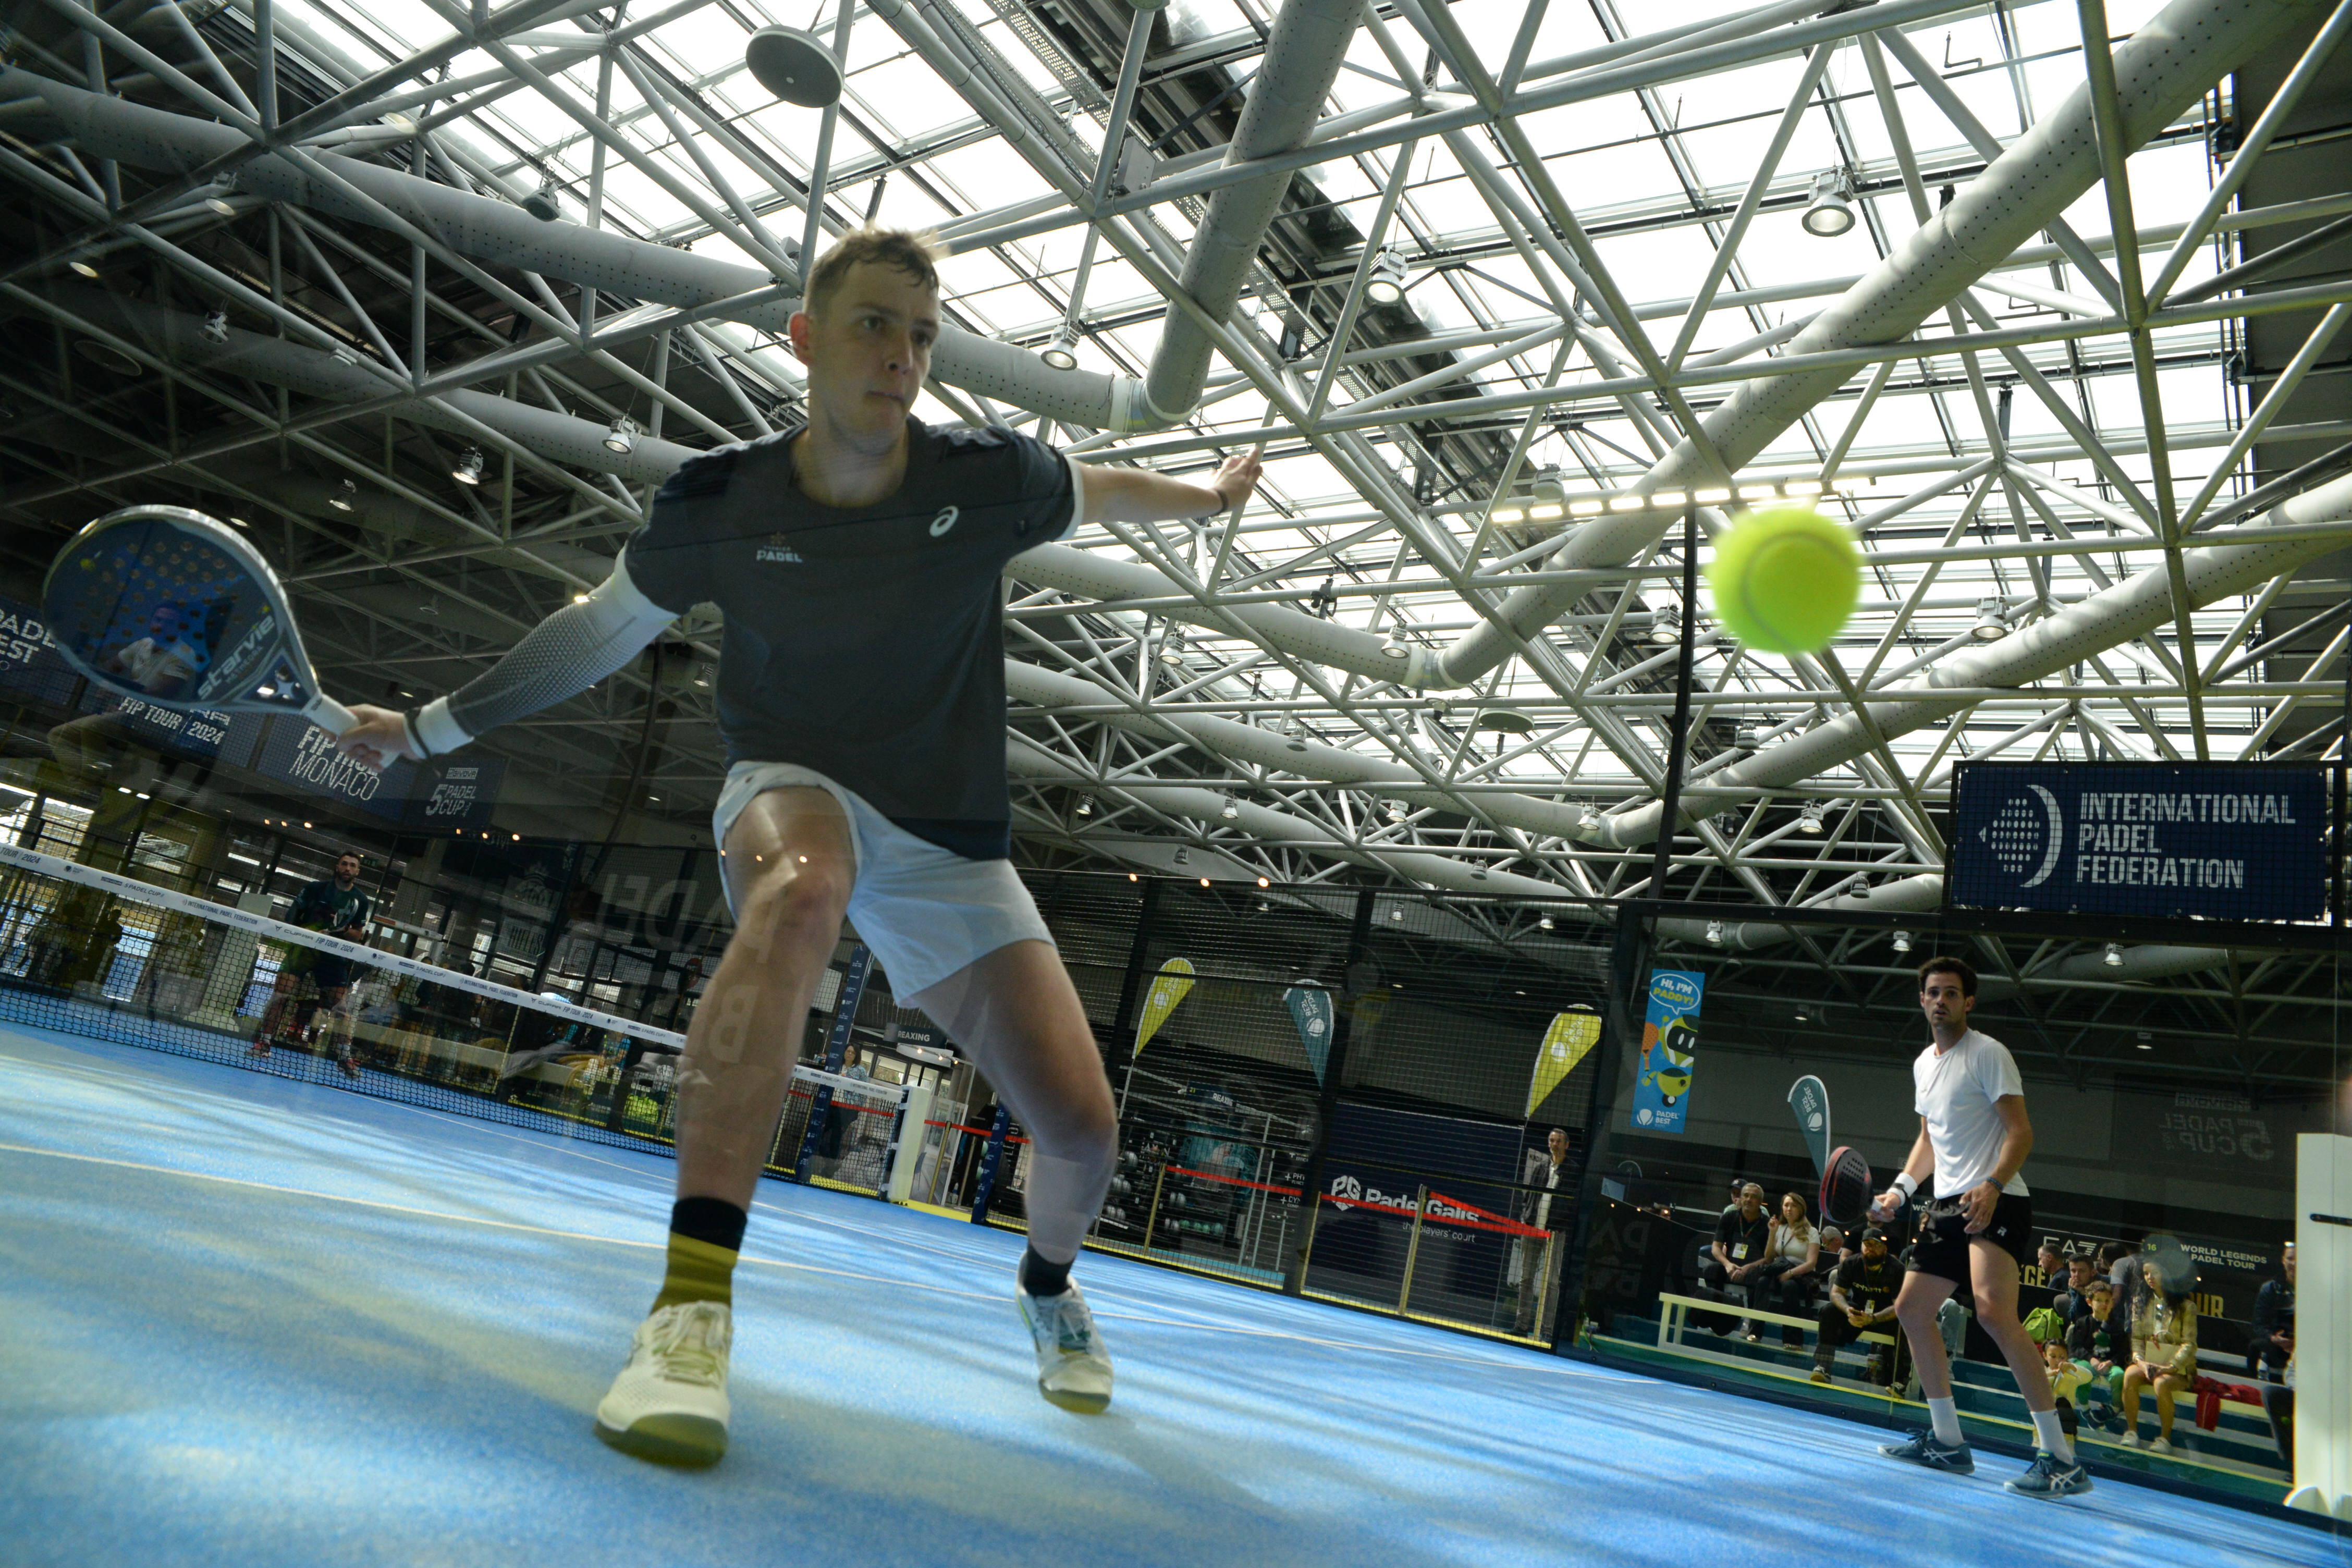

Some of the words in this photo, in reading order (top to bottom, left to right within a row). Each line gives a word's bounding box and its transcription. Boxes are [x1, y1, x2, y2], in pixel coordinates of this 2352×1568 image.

[756, 549, 803, 563] PADEL
[118, 696, 146, 716] FIP
[144, 705, 183, 730] TOUR
[187, 721, 226, 745] 2024
[288, 751, 380, 801] MONACO
[425, 783, 449, 816] 5
[444, 785, 476, 799] PADEL
[438, 799, 466, 815] CUP
[2081, 792, 2297, 824] INTERNATIONAL
[2078, 824, 2162, 854] PADEL
[1, 847, 18, 858] TOUR
[21, 853, 42, 864] 2024
[2076, 855, 2244, 889] FEDERATION
[128, 884, 147, 893] PADEL
[325, 939, 339, 948] TOUR
[340, 944, 354, 953] 2024
[1652, 986, 1694, 1006] PADDY!
[898, 1030, 930, 1042] REAXING
[1655, 1117, 1671, 1125] BEST
[1656, 1110, 1679, 1120] PADEL
[1452, 1228, 1476, 1243] court
[2147, 1243, 2157, 1252] 16
[2180, 1243, 2218, 1256] WORLD
[2220, 1250, 2268, 1264] LEGENDS
[2191, 1253, 2225, 1266] PADEL
[2226, 1258, 2256, 1270] TOUR
